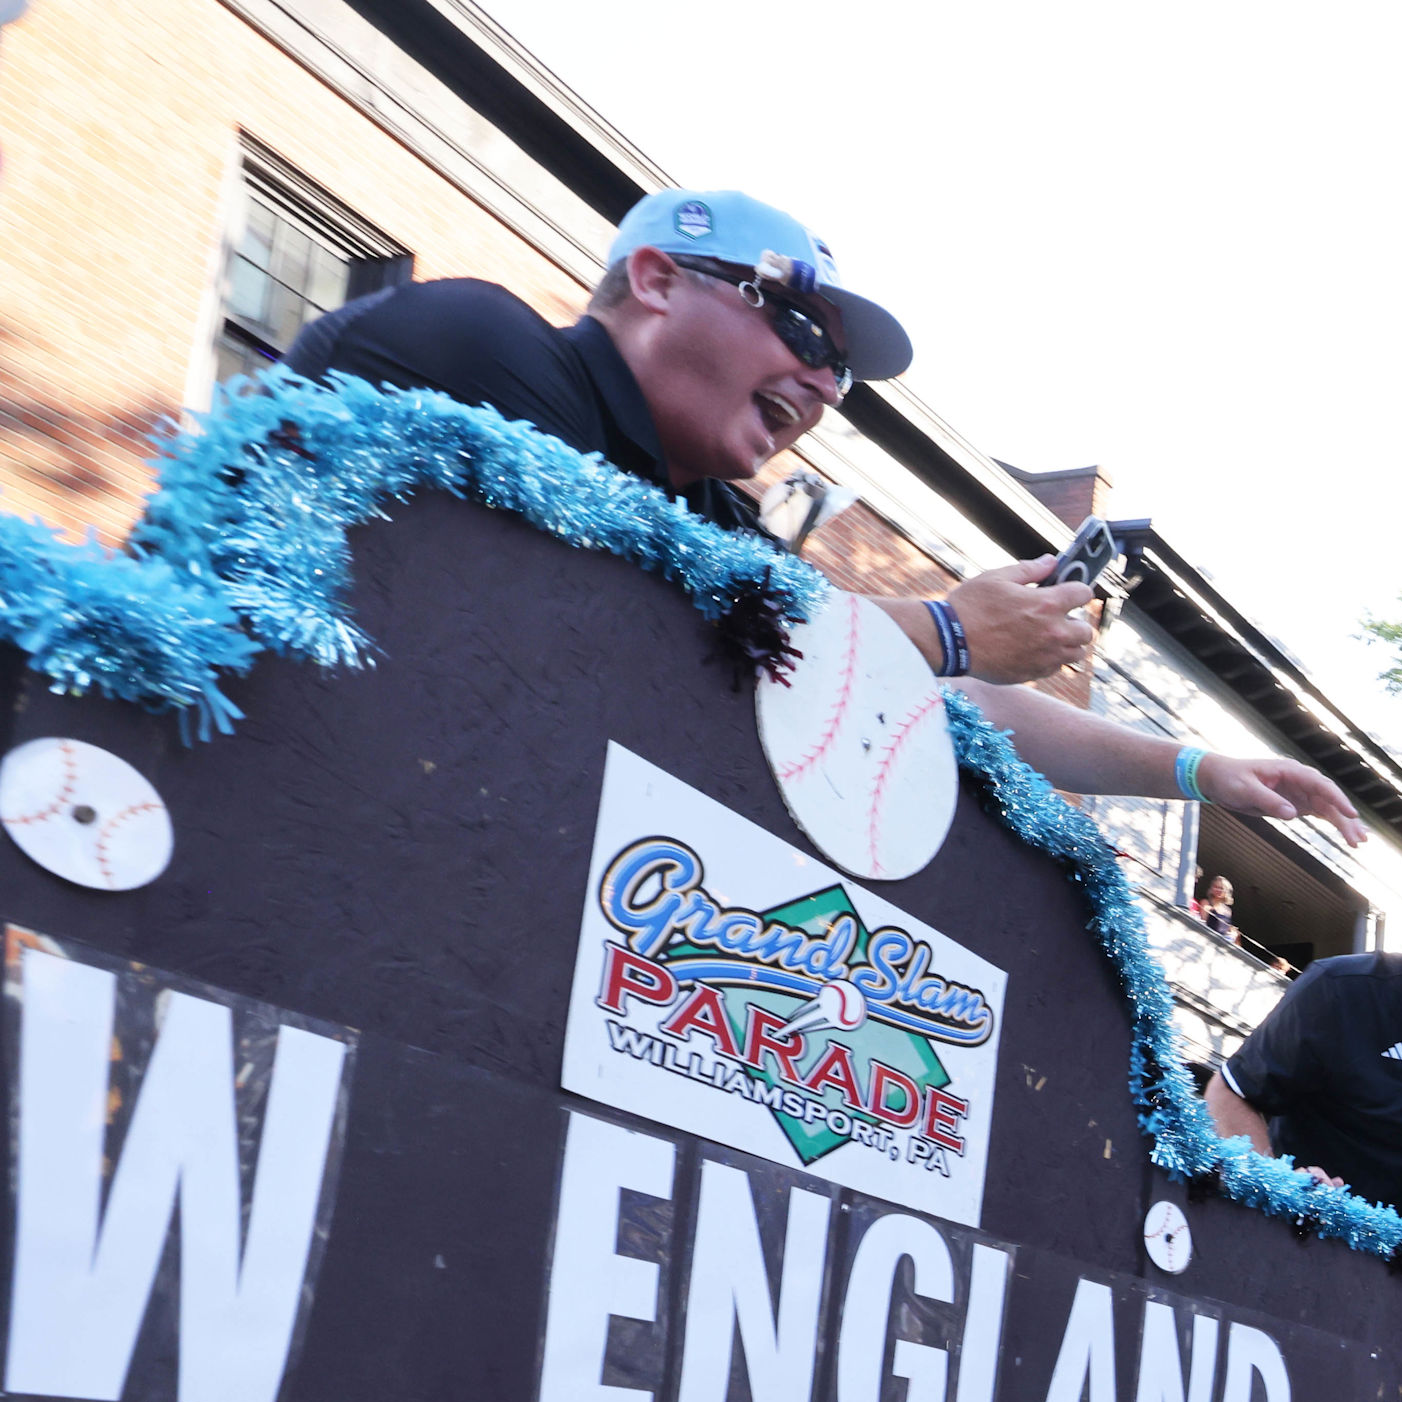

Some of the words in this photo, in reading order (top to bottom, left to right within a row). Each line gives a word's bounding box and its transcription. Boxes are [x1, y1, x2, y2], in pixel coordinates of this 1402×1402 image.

[599, 836, 858, 985] Grand
[848, 925, 993, 1032] Slam
[597, 941, 968, 1156] PARADE
[606, 1020, 900, 1161] WILLIAMSPORT,
[907, 1138, 951, 1178] PA
